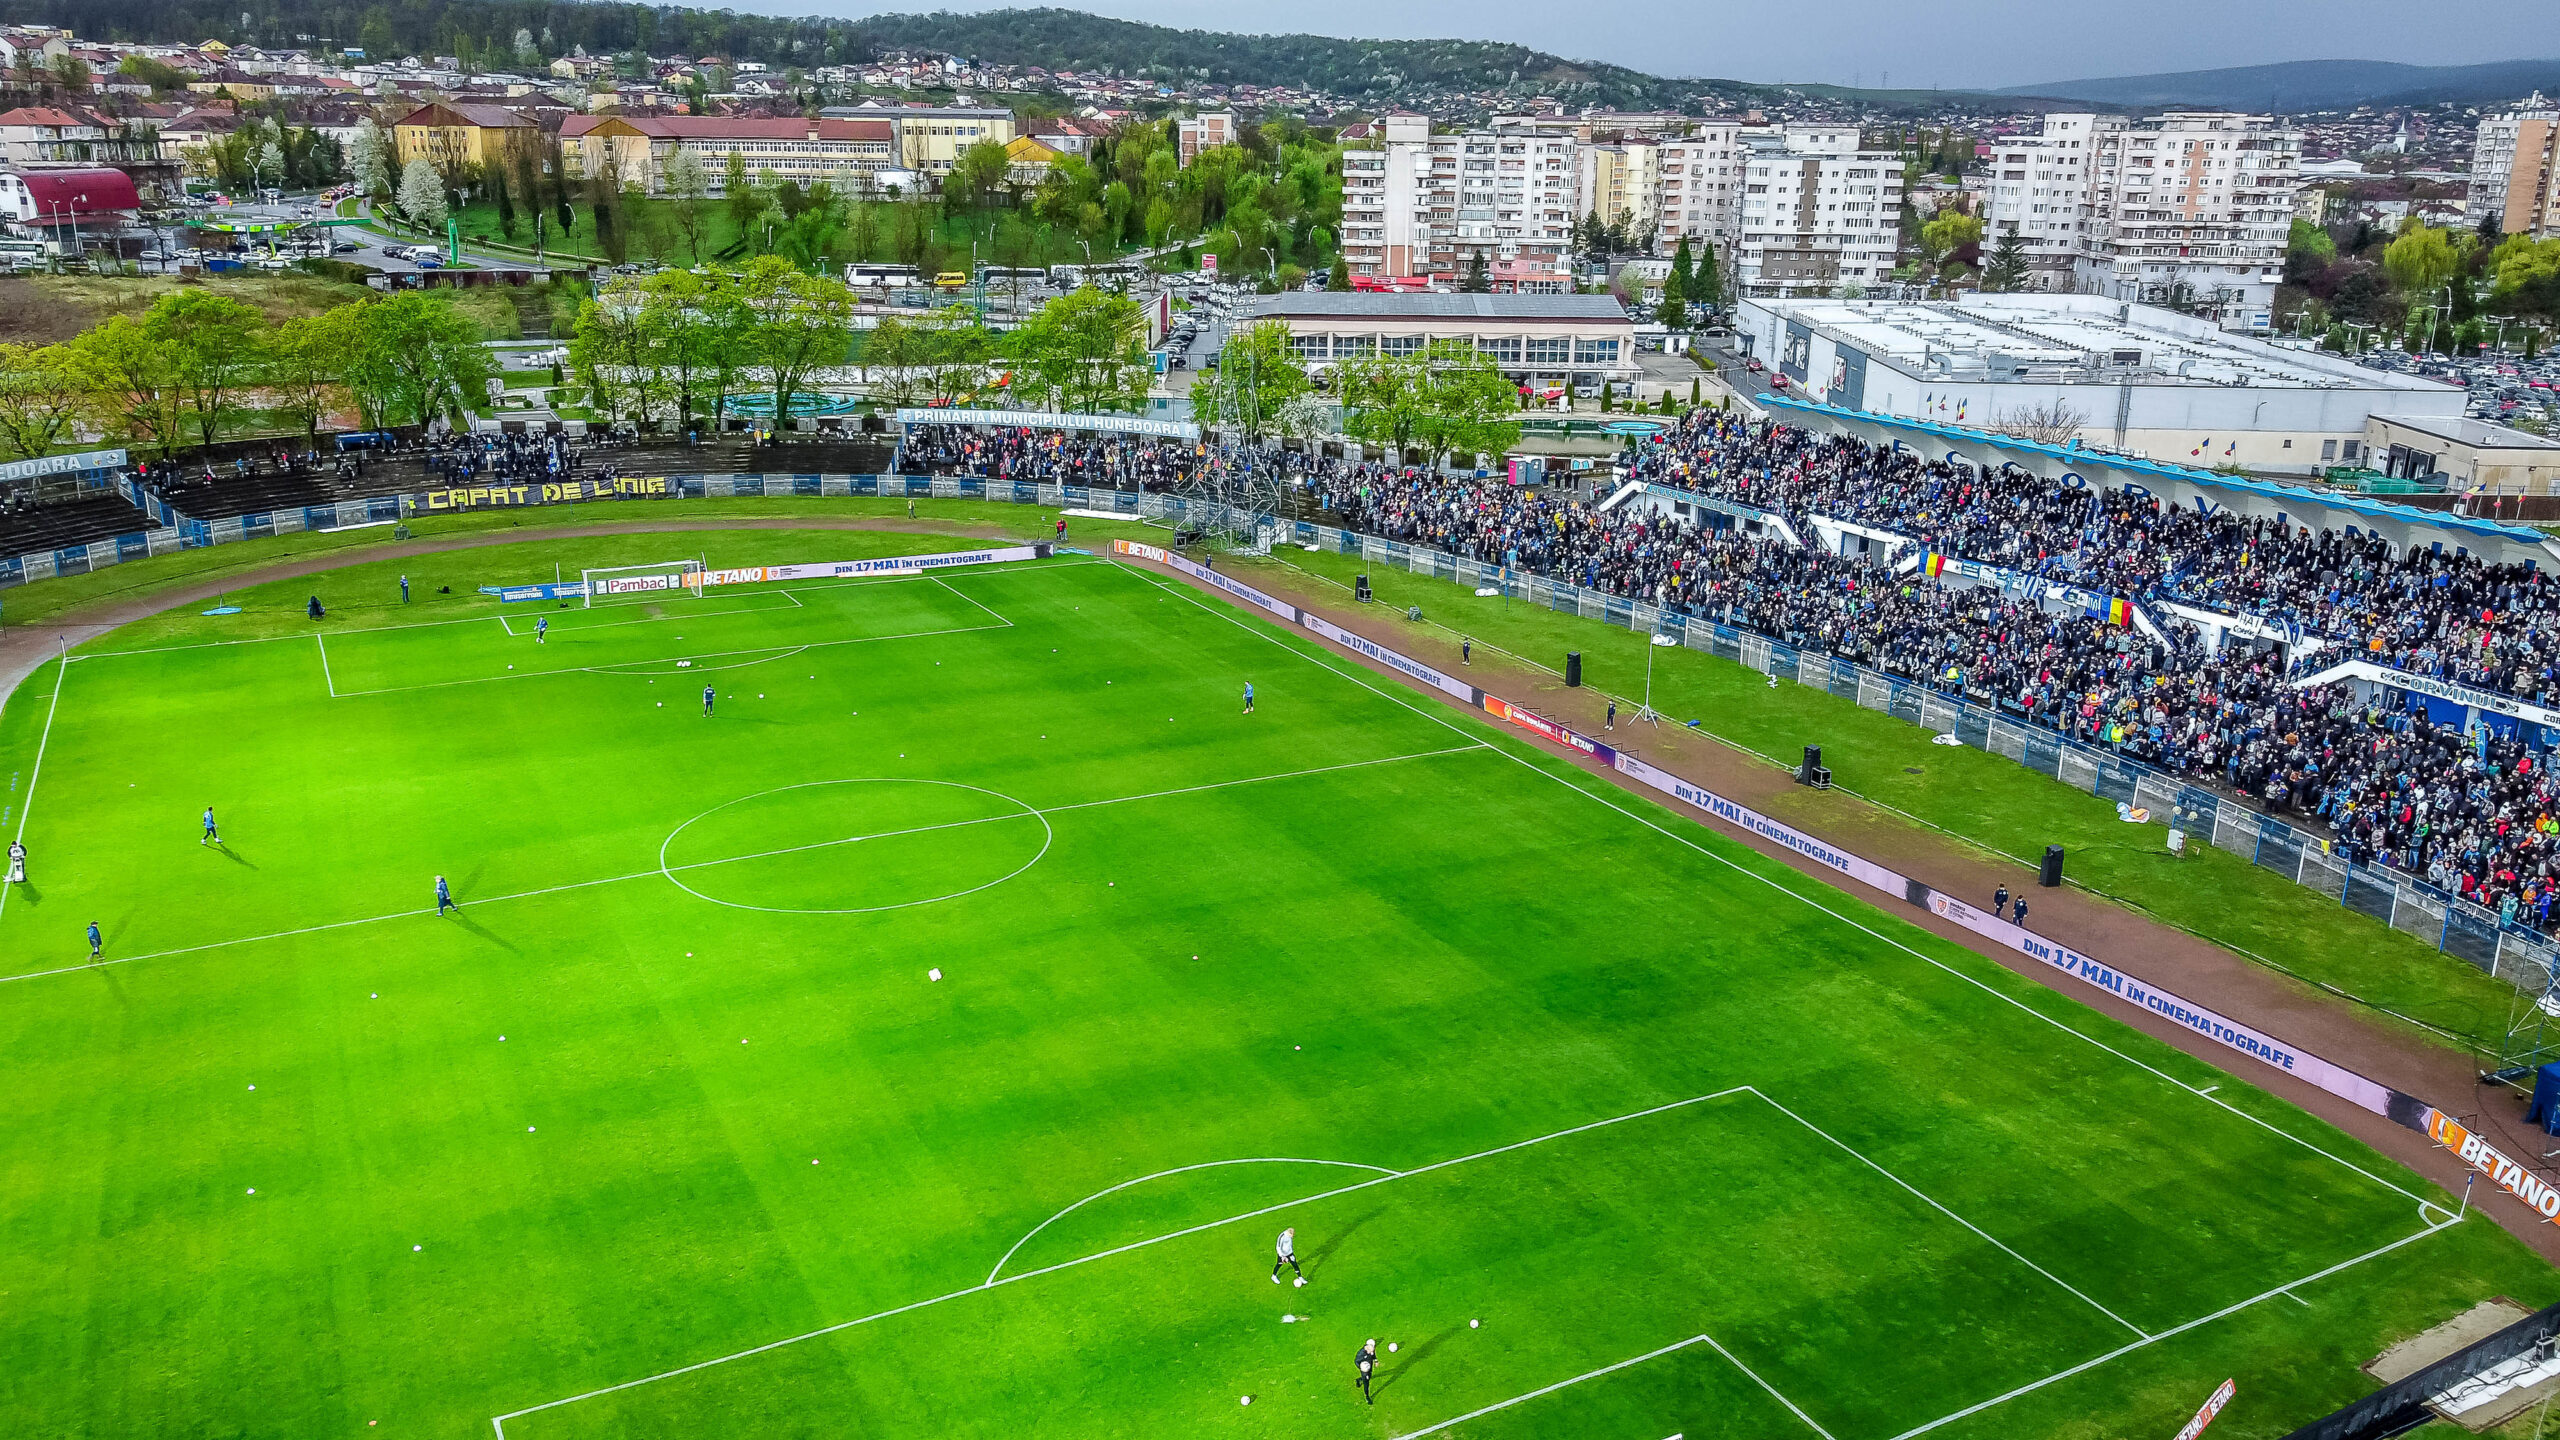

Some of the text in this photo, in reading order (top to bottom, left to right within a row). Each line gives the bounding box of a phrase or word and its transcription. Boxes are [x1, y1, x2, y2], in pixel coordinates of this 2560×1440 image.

[914, 410, 1181, 436] PRIMARIA MUNICIPIULUI HUNEDOARA
[541, 482, 582, 502] DE
[835, 565, 853, 574] DIN
[855, 562, 870, 572] 17
[873, 559, 899, 571] MAI
[914, 553, 993, 567] CINEMATOGRAFE
[1128, 542, 1165, 562] BETANO
[610, 578, 665, 593] Pambac
[703, 568, 763, 585] BETANO
[1204, 570, 1213, 584] 17
[1351, 637, 1362, 649] 17
[1362, 641, 1379, 658] MAI
[1387, 654, 1441, 687] CINEMATOGRAFE
[2395, 674, 2503, 711] CORVINUL
[1570, 736, 1594, 753] BETANO
[1675, 784, 1849, 871] DIN 17 MAI ÎN CINEMATOGRAFE
[2023, 937, 2294, 1070] DIN 17 MAI ÎN CINEMATOGRAFE
[2459, 1133, 2560, 1218] BETANO
[2210, 1383, 2234, 1416] BETANO
